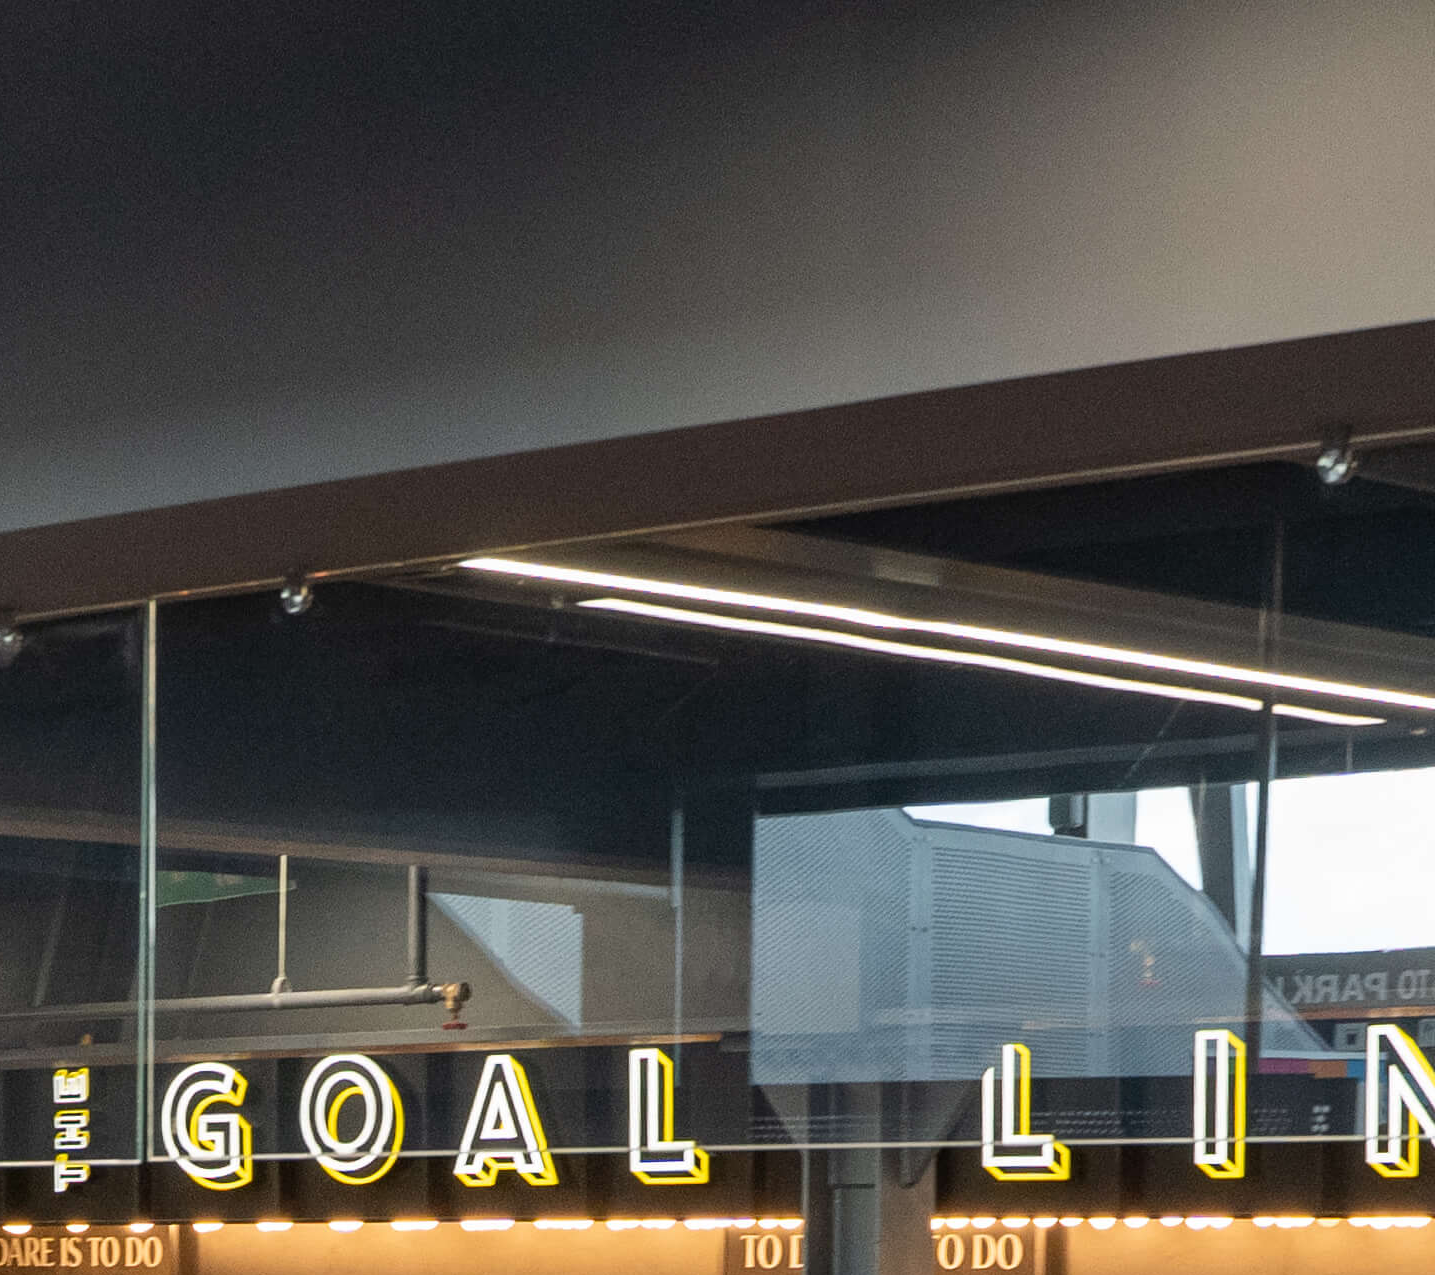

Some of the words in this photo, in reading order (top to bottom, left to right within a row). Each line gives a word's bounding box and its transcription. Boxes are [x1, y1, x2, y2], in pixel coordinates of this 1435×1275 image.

[53, 1067, 91, 1193] THE
[161, 1048, 710, 1190] GOAL
[60, 1236, 83, 1268] IS
[86, 1236, 120, 1268] TO
[125, 1236, 164, 1268] DO
[739, 1233, 783, 1270] TO
[932, 1233, 965, 1270] O
[970, 1233, 1024, 1271] DO
